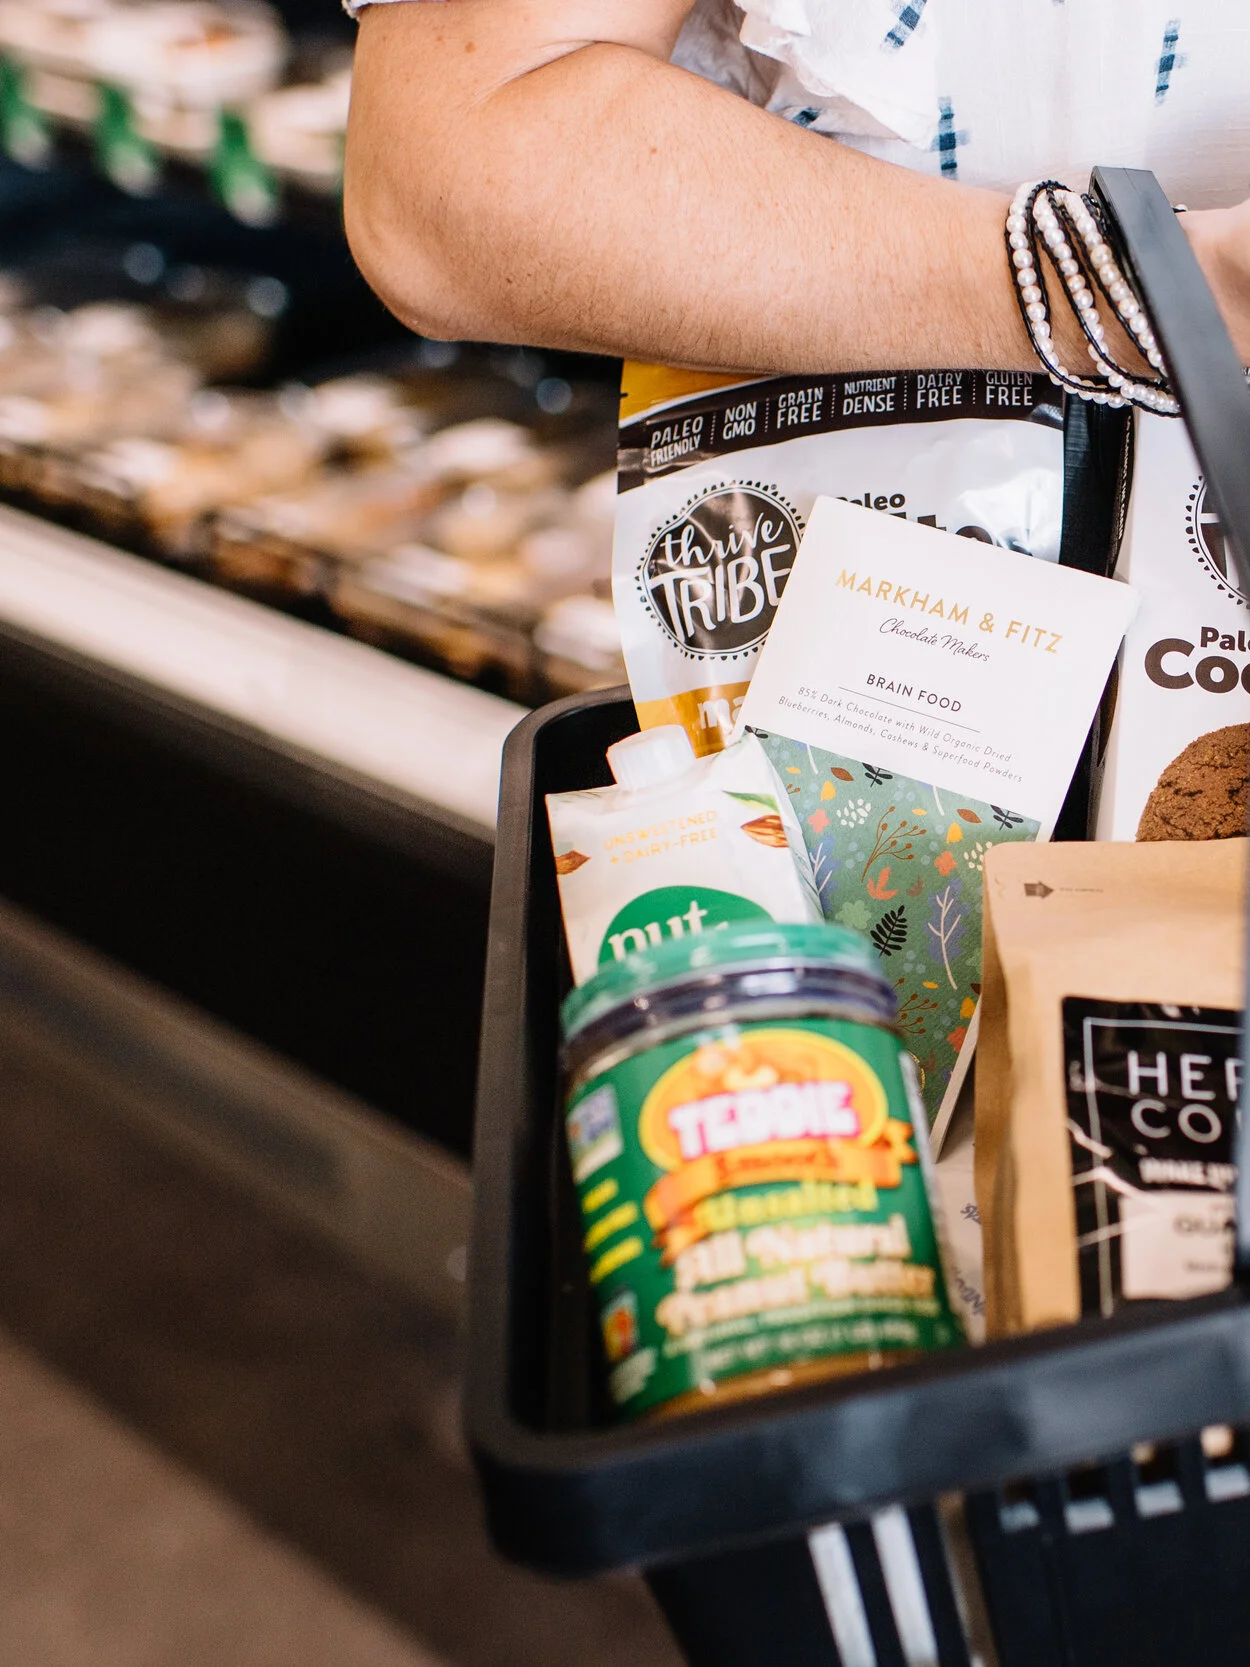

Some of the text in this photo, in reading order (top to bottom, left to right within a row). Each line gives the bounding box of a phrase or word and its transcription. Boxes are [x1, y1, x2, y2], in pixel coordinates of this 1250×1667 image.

[844, 377, 897, 396] NUTRIENT
[916, 372, 963, 390] DAIRY
[985, 371, 1033, 386] GLUTEN
[724, 401, 757, 424] NON
[778, 387, 824, 409] GRAIN
[842, 393, 896, 416] DENSE
[916, 386, 963, 409] FREE
[985, 386, 1034, 406] FREE
[722, 419, 756, 441] GMO
[776, 401, 822, 429] FREE
[650, 416, 704, 449] PALEO
[650, 434, 702, 468] FRIENDLY
[660, 512, 784, 567] thrive
[650, 543, 792, 645] TRIBE
[835, 568, 1064, 655] MARKHAM & FITZ
[879, 617, 990, 663] Chocolate Makers
[866, 673, 962, 713] BRAIN FOOD
[778, 695, 1023, 783] Blueberries, Almonds, Cashews & Superfood Powders
[797, 686, 1012, 763] 85% Dark Chocolate with Wild Organic Dried
[603, 809, 719, 851] UNSWEETENED
[622, 826, 719, 865] DAIRY-FREE
[667, 1080, 861, 1161] TEDDIE
